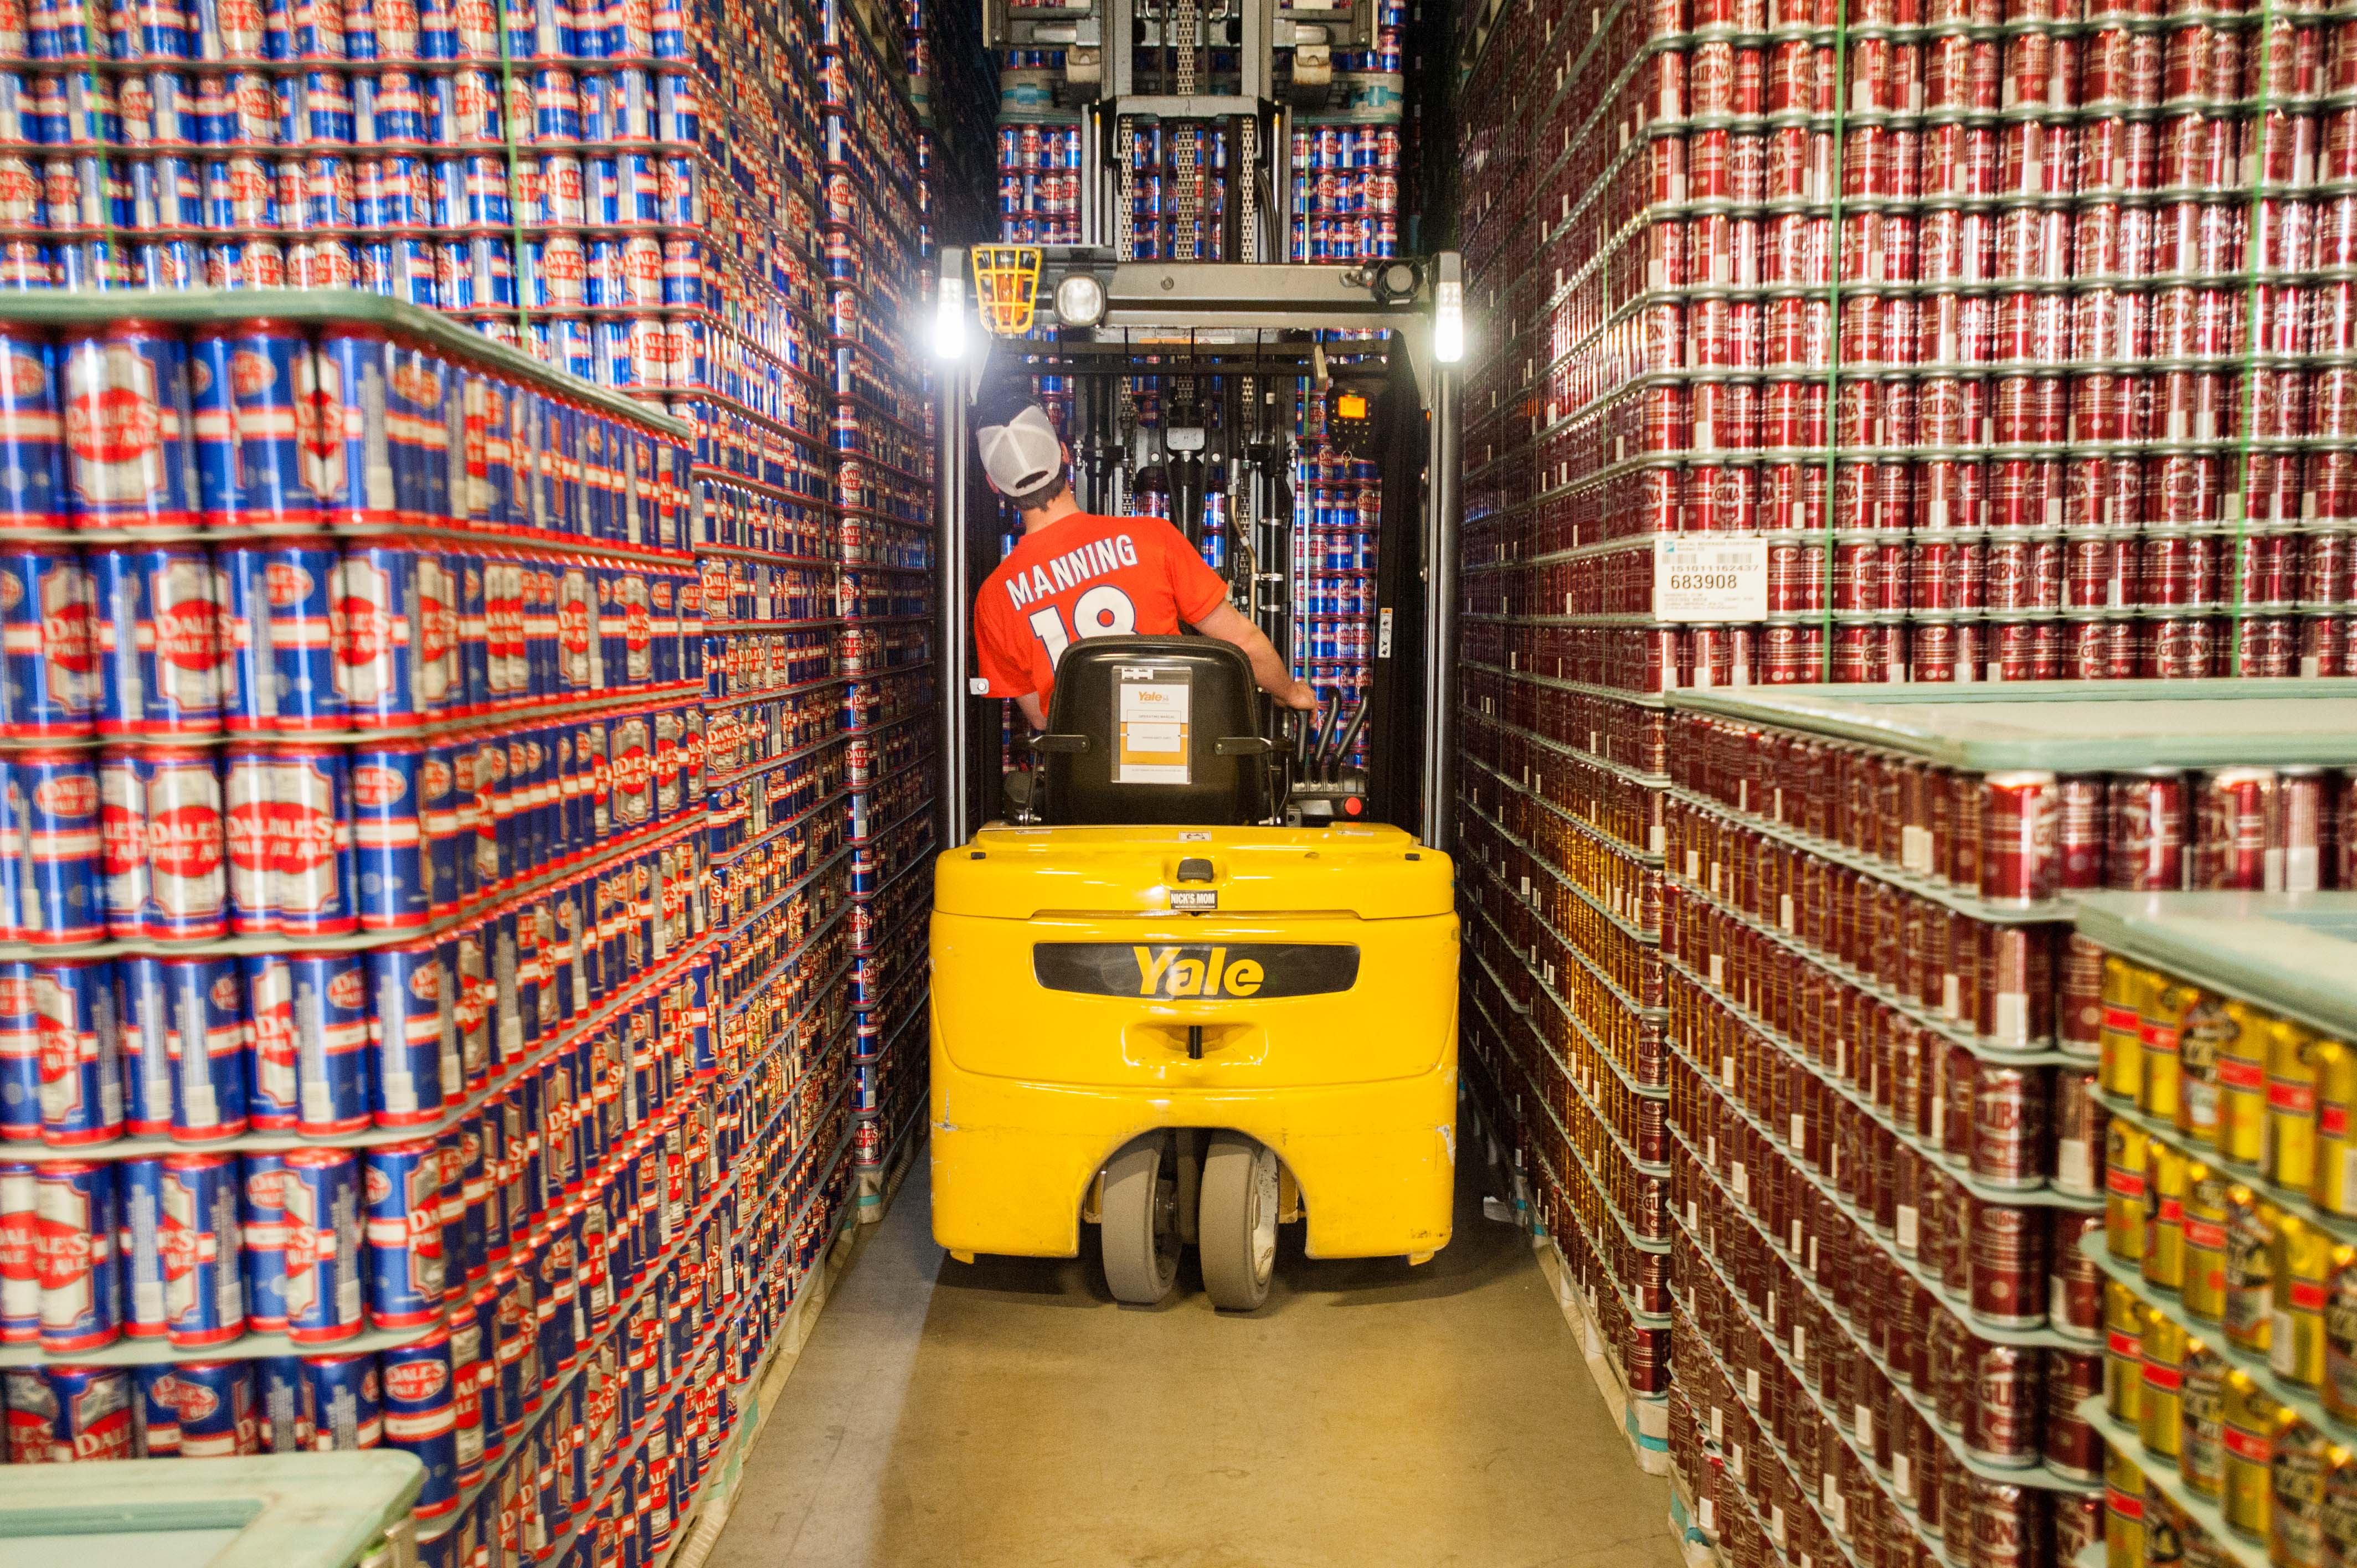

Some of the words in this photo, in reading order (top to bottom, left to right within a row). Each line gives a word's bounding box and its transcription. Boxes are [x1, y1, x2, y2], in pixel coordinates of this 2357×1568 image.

[1005, 534, 1138, 611] MANNING
[1671, 574, 1737, 589] 683908
[1139, 690, 1162, 701] Yale
[1171, 893, 1195, 904] NICK'S
[1197, 893, 1215, 904] MOM
[1133, 946, 1264, 996] Yale
